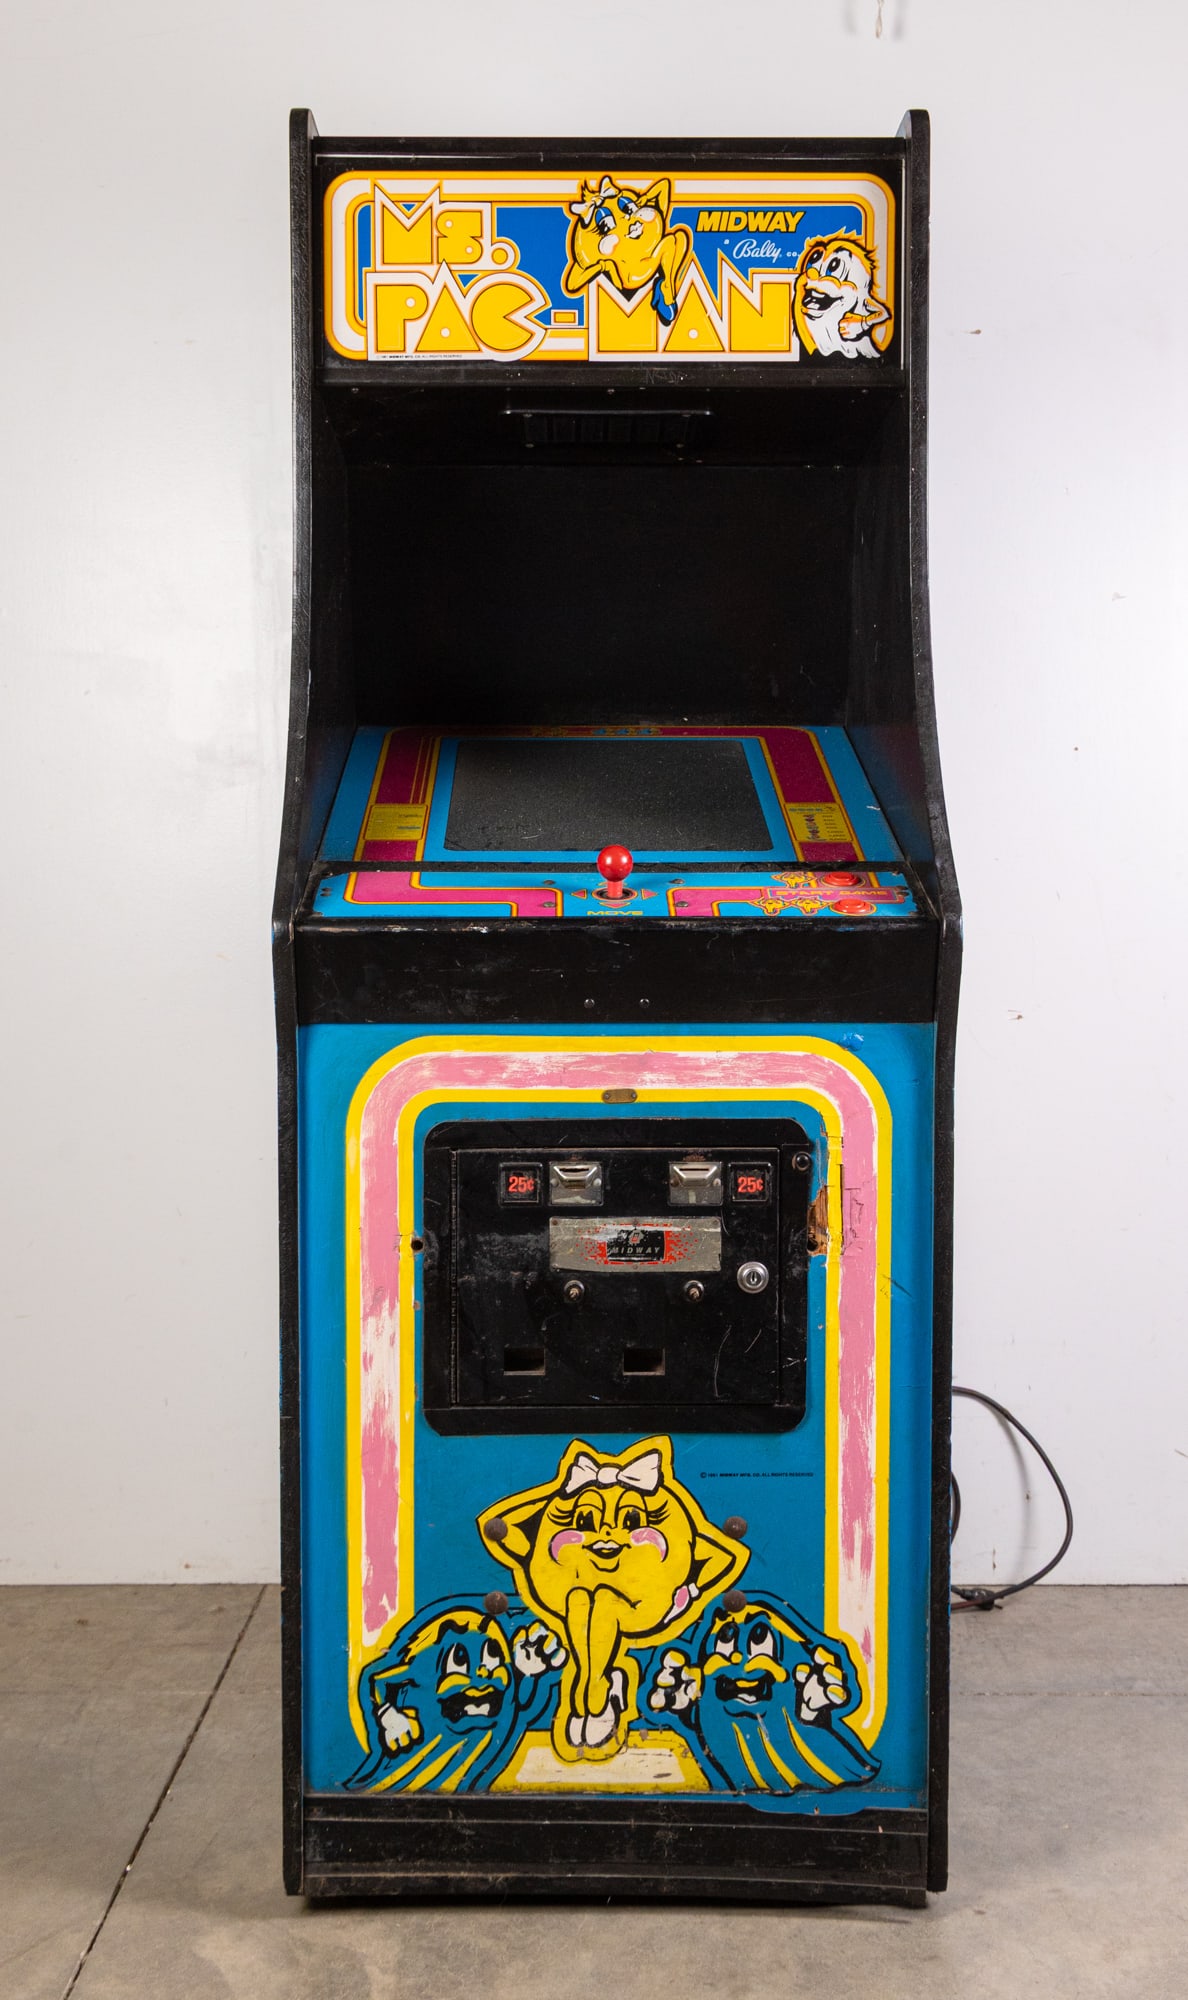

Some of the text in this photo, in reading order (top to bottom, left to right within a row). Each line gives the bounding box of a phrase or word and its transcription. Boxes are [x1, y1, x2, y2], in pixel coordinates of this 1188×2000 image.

[696, 210, 806, 233] MIDWAY
[732, 238, 781, 264] Bally
[366, 259, 800, 361] PAC-MAN
[508, 1175, 535, 1193] 25¢
[737, 1175, 764, 1193] 25¢
[611, 1246, 660, 1254] MIDWAY
